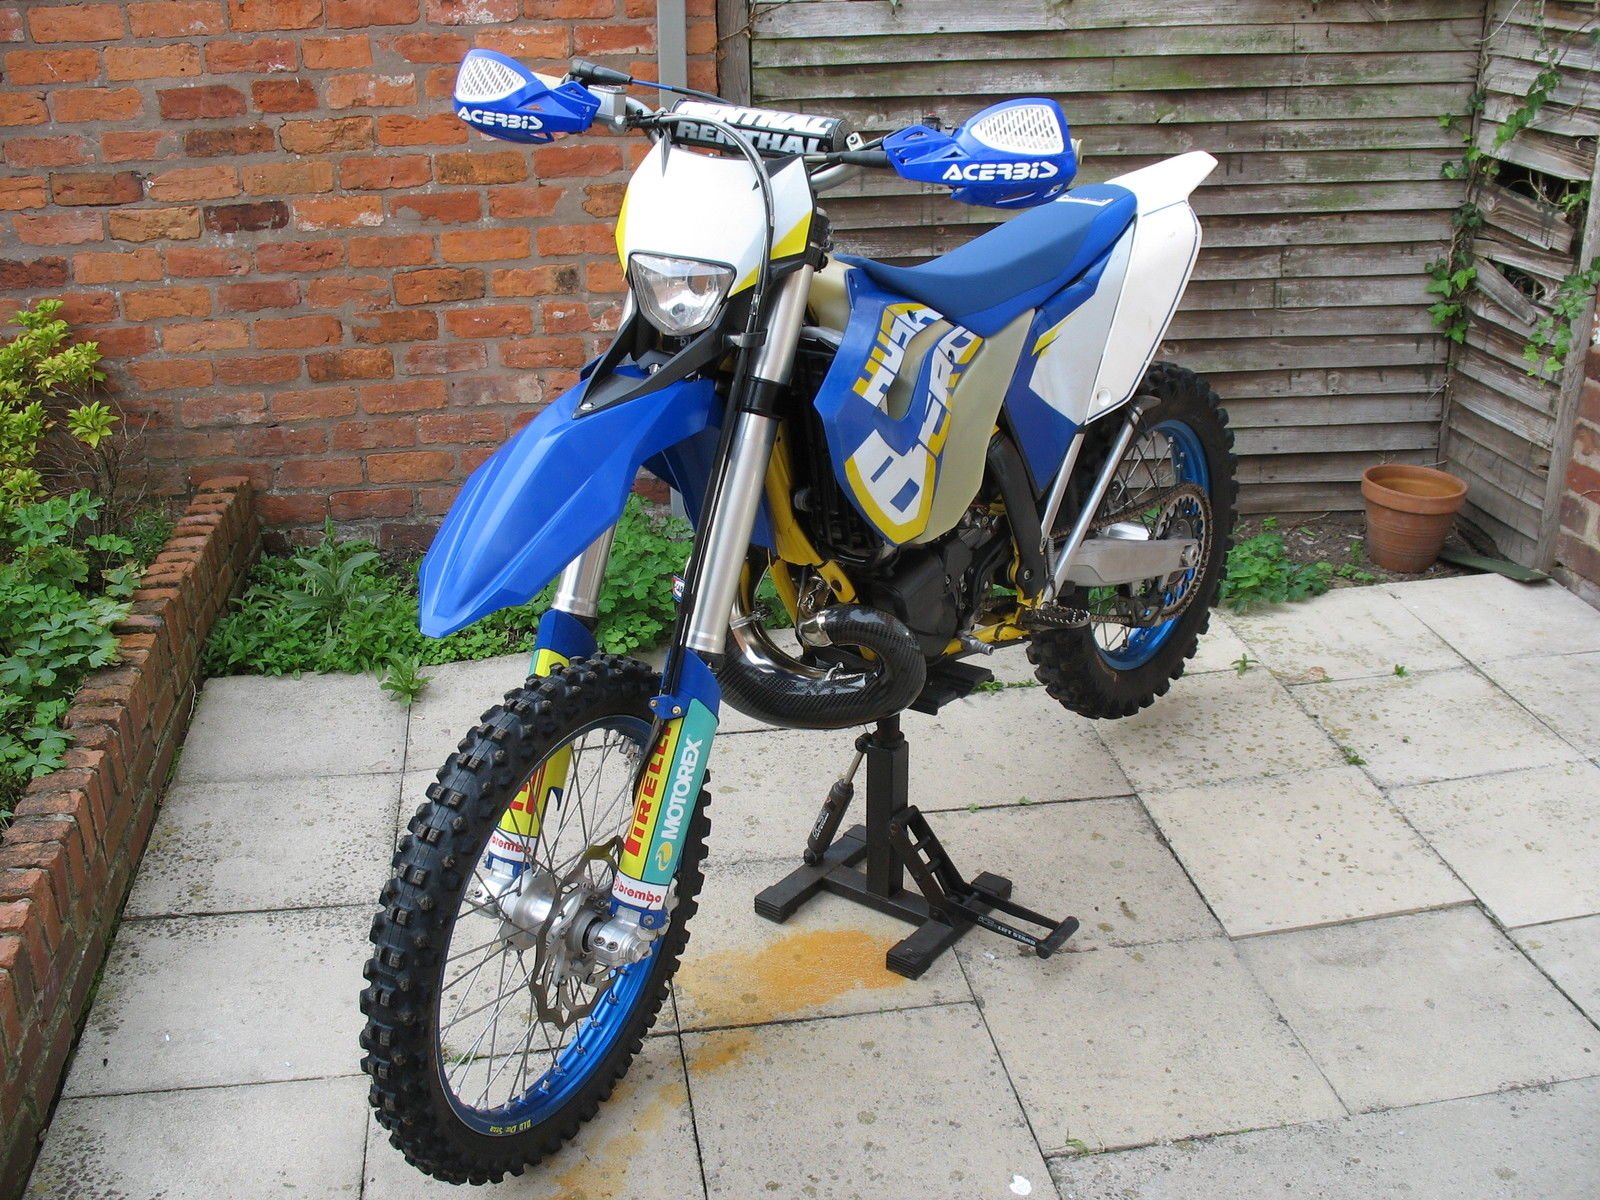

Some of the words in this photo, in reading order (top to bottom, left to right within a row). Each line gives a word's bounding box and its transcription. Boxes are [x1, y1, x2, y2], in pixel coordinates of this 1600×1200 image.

[457, 106, 543, 131] ACERBIS
[942, 160, 1059, 182] ACERBIS
[661, 737, 704, 840] MOTOREX
[618, 879, 663, 904] brembo
[1013, 933, 1036, 946] STAND
